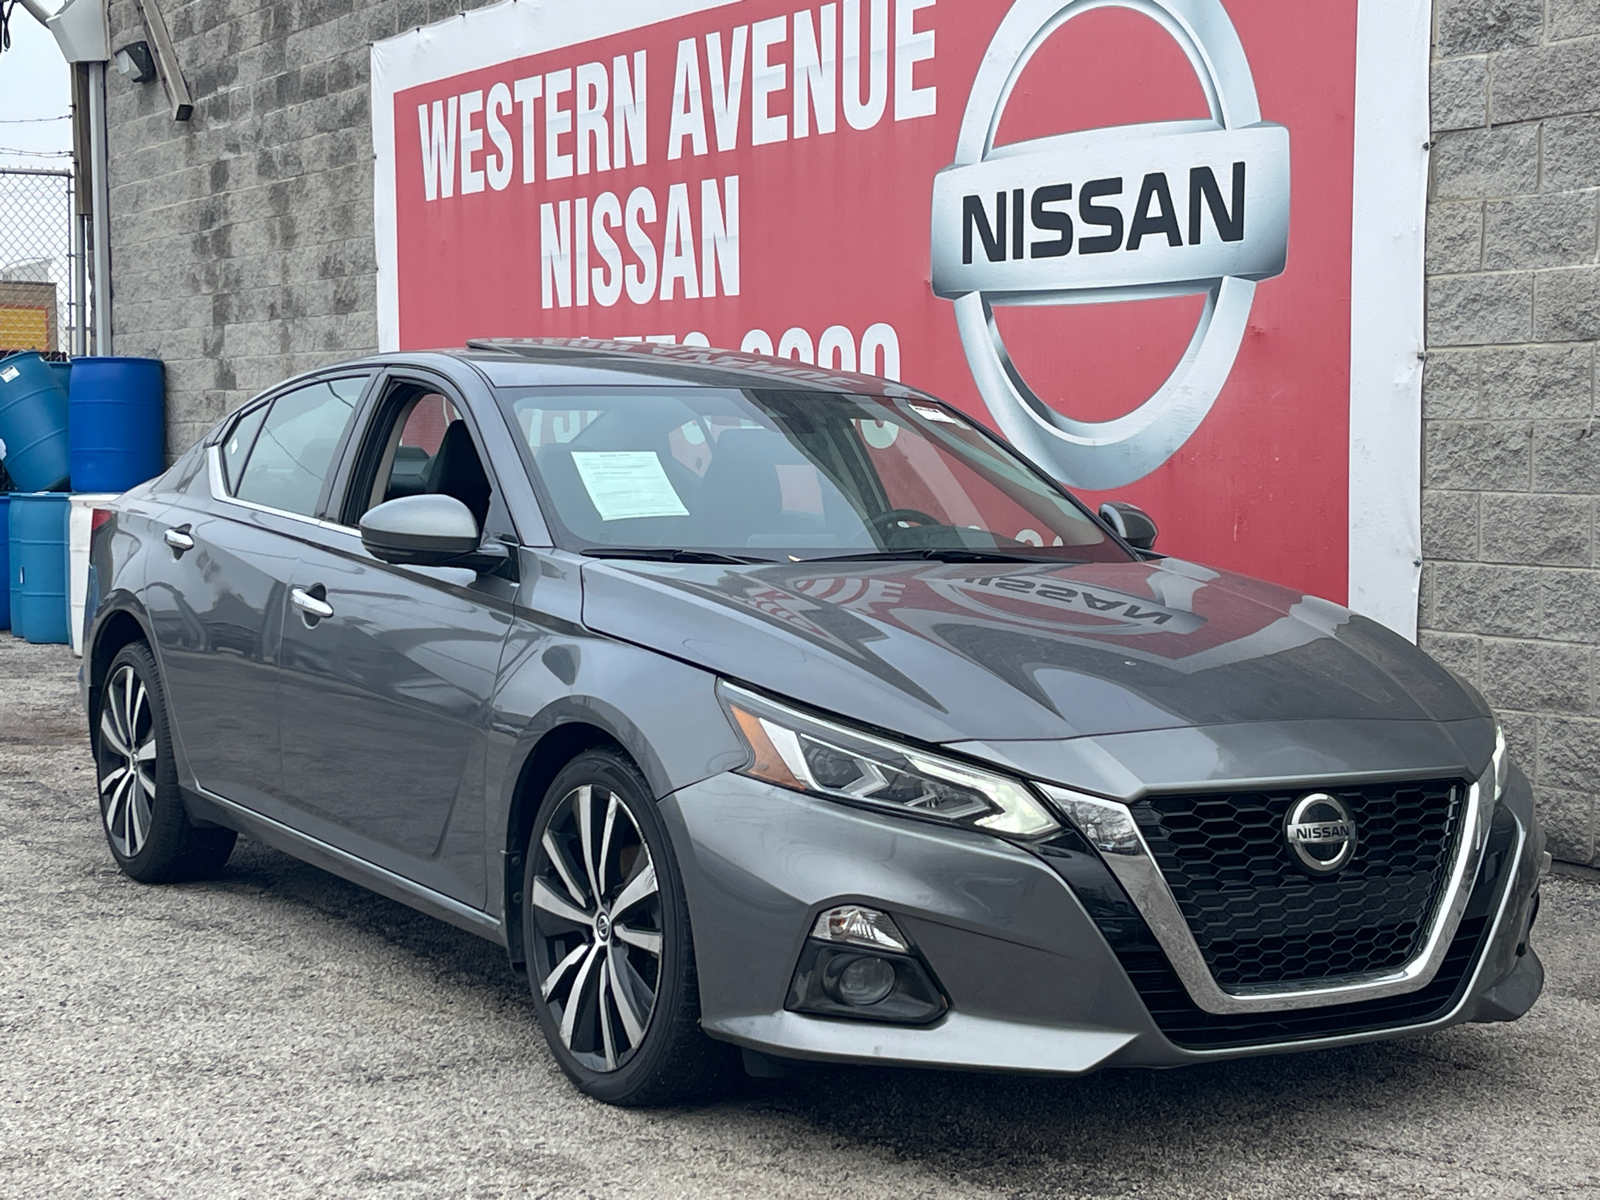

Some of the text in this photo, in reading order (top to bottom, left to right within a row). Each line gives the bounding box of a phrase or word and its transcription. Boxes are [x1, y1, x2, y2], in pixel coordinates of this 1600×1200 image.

[417, 0, 937, 201] WESTERN AVENUE
[540, 175, 740, 309] NISSAN
[961, 161, 1246, 265] NISSAN
[1296, 825, 1349, 839] NISSAN
